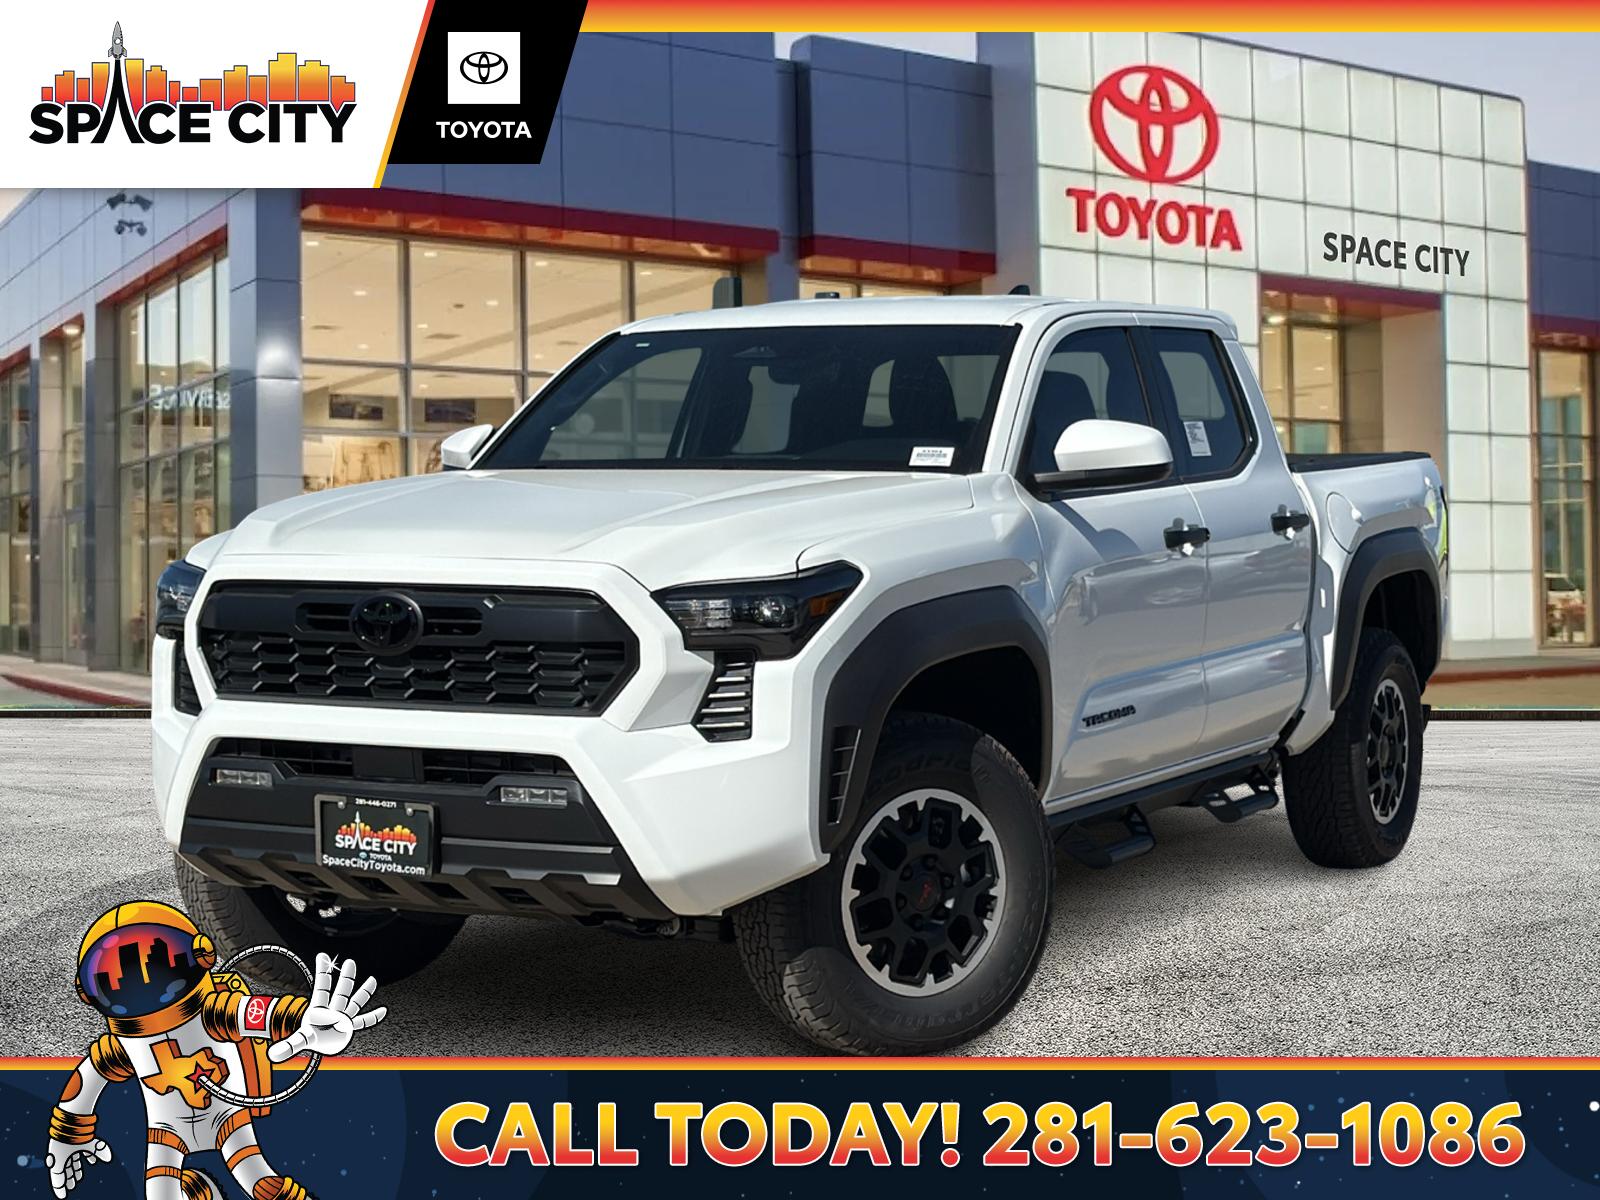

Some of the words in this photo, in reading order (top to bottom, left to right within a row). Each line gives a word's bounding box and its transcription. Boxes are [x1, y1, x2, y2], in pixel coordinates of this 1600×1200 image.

[1065, 188, 1242, 252] TOYOTA
[1323, 232, 1407, 270] SPACE
[1415, 244, 1471, 277] CITY
[1082, 704, 1136, 728] TACOMA
[335, 823, 381, 851] SPACE
[383, 839, 417, 855] CITY
[322, 854, 425, 875] SpaceCityToyota.com
[369, 853, 392, 861] TOYOTA
